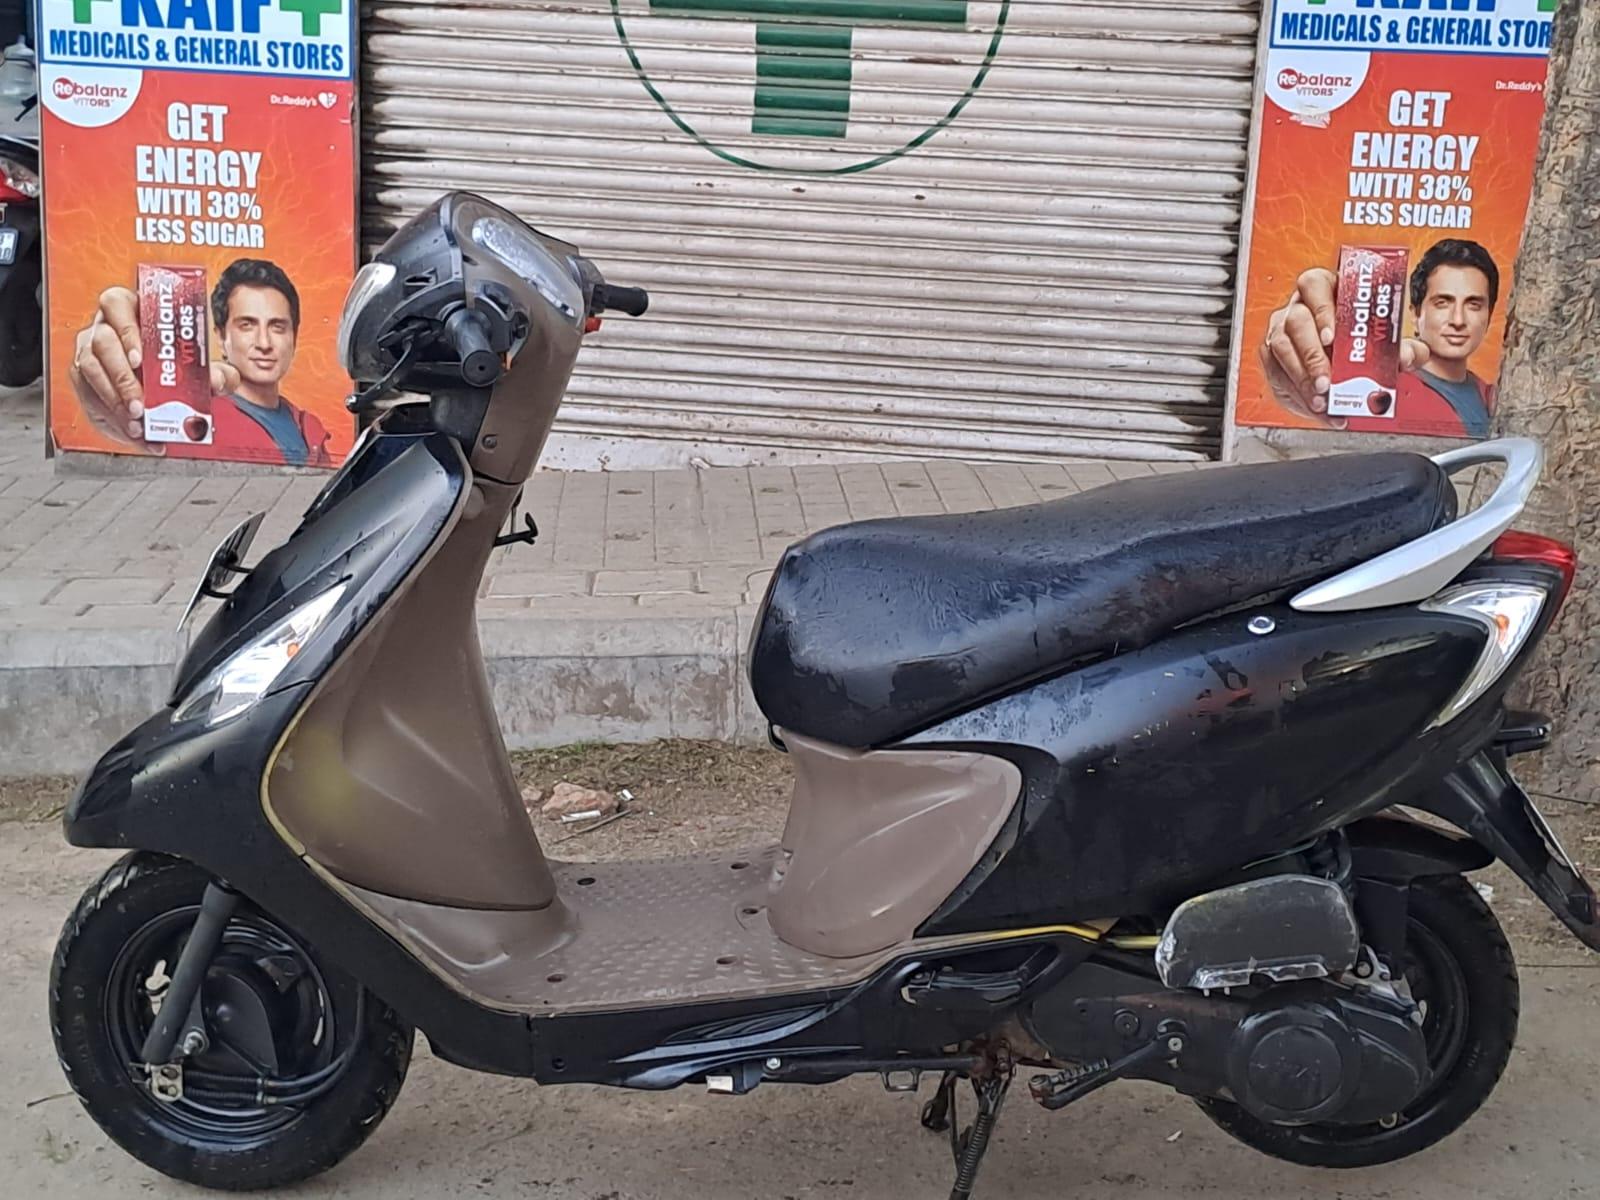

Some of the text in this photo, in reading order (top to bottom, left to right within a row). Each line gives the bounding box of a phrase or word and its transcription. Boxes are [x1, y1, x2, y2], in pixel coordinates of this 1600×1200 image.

[1280, 13, 1551, 48] MEDICALS & GENERAL STOR
[50, 29, 343, 71] MEDICALS & GENERAL STORES
[53, 77, 127, 99] Rebalanz
[1277, 68, 1352, 90] Rebalanz
[167, 102, 228, 142] GET
[1388, 89, 1451, 127] GET
[136, 145, 262, 188] ENERGY
[1352, 132, 1479, 171] ENERGY
[136, 187, 262, 220] WITH 38%
[1349, 172, 1472, 202] WITH 38%
[1343, 201, 1472, 228] LESS SUGAR
[136, 218, 264, 248] LESS SUGAR
[1349, 263, 1373, 362] Rebalanz
[157, 283, 176, 386] Rebalanz
